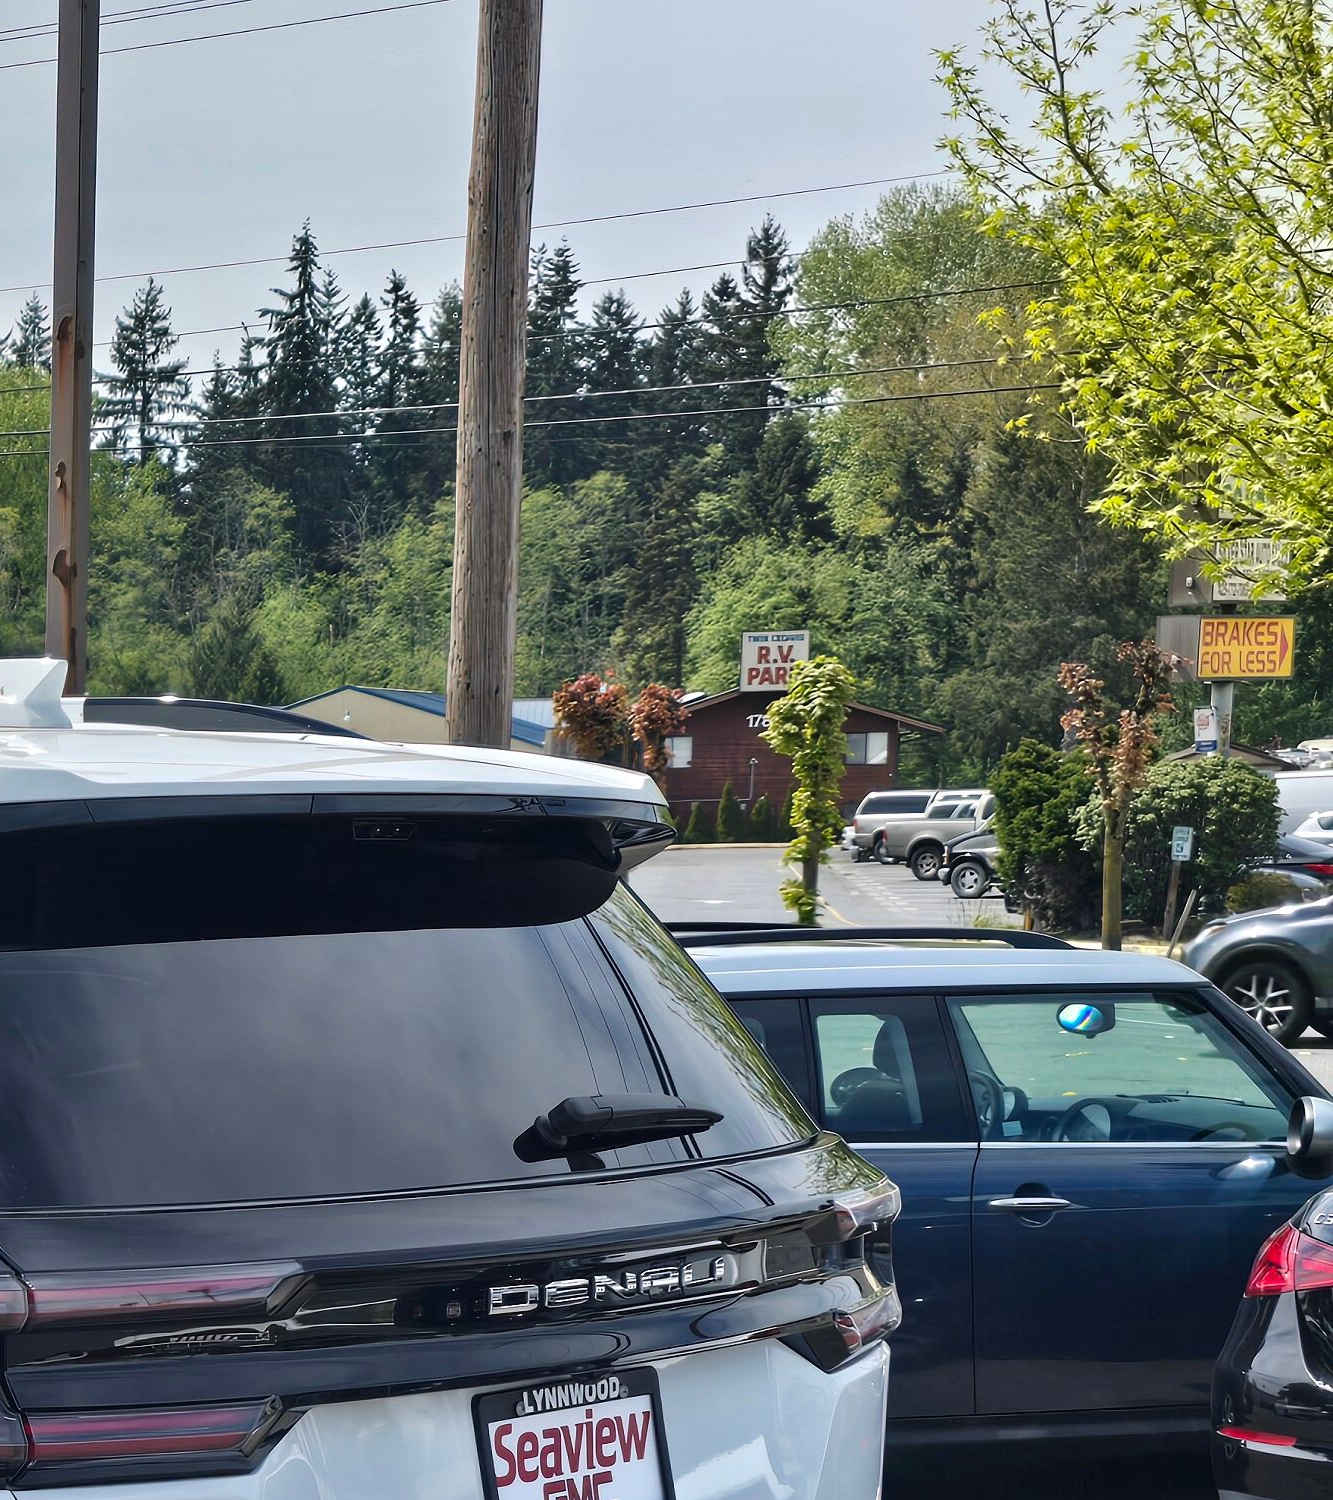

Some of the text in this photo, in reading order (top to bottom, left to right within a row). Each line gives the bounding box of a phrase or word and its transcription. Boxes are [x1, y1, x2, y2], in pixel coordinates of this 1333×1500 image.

[1202, 621, 1279, 647] BRAKES
[757, 645, 796, 664] R.V.
[1200, 650, 1276, 675] FOR LESS
[747, 667, 794, 686] PAR
[489, 1256, 726, 1316] DENALI
[522, 1376, 620, 1414] LYNNWOOD
[494, 1409, 651, 1488] Seaview
